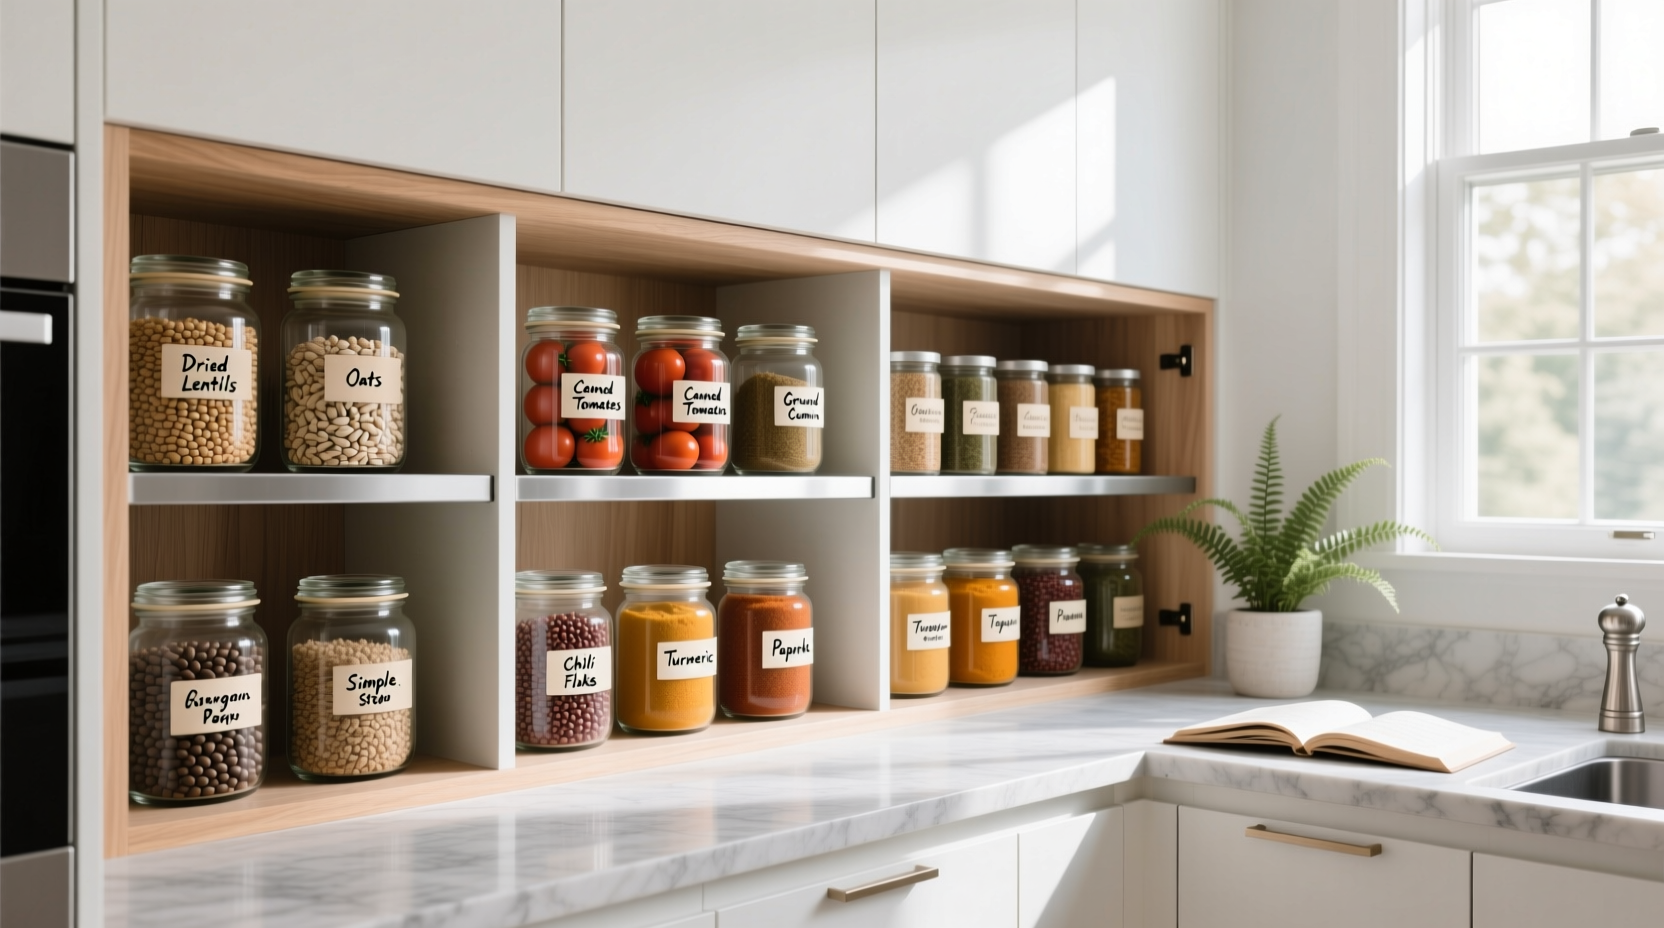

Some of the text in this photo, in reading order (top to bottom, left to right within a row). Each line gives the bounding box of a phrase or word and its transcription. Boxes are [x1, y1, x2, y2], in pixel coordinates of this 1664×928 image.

[182, 353, 229, 372] Dried
[346, 367, 382, 387] Oats
[563, 653, 595, 671] Chili
